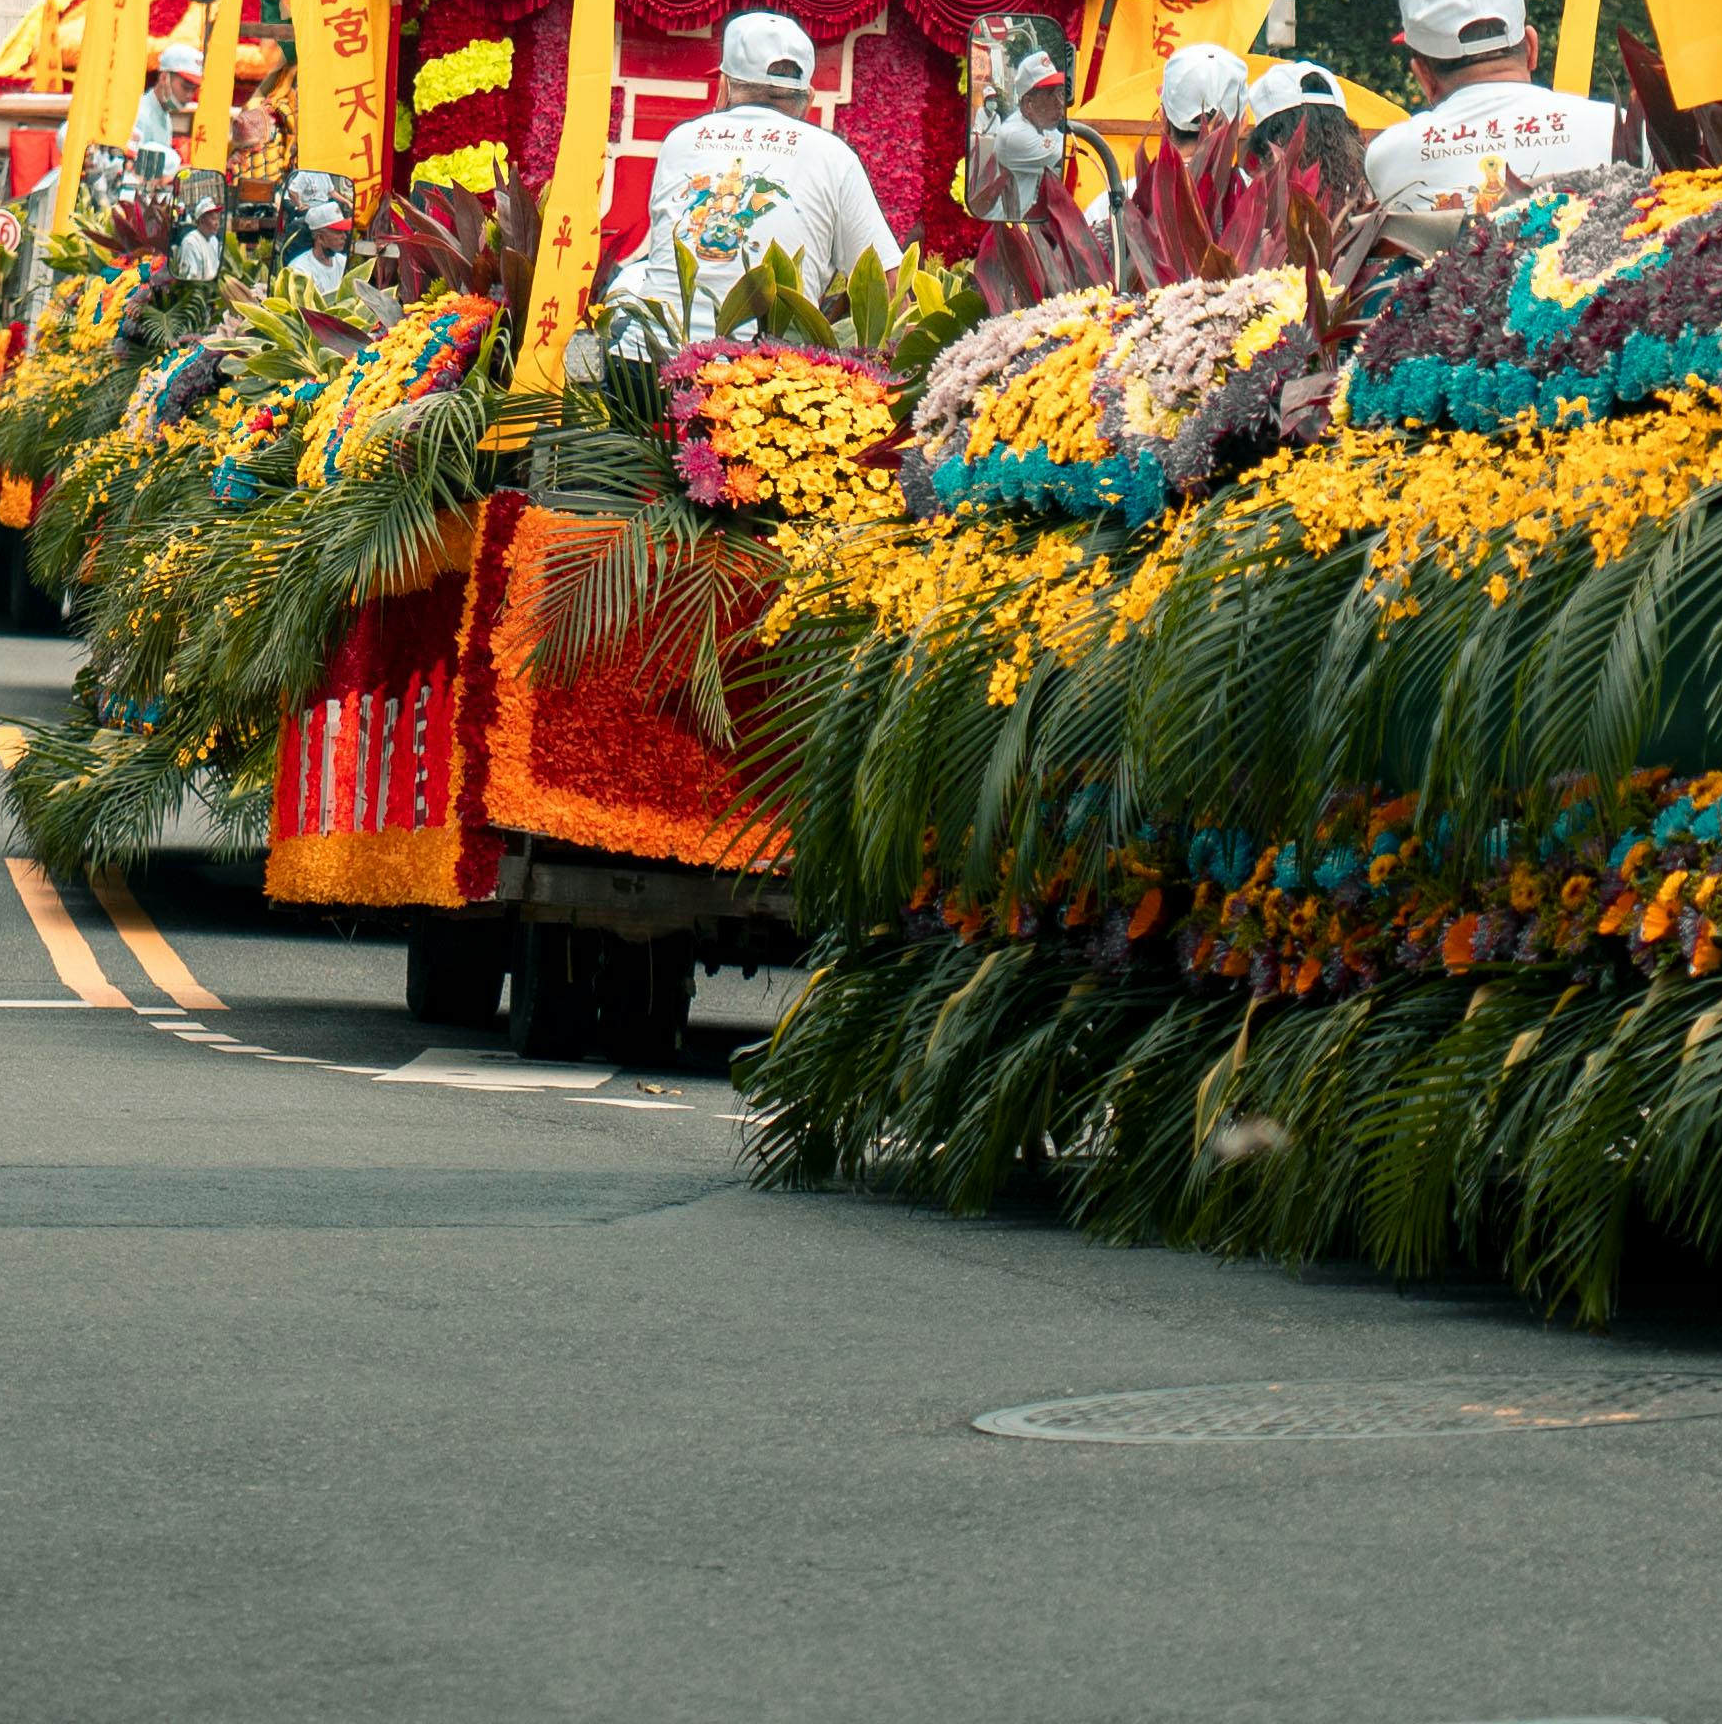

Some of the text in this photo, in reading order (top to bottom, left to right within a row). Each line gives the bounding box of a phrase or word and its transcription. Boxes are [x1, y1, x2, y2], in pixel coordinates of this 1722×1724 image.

[1422, 112, 1568, 145] 松山慈祐宮
